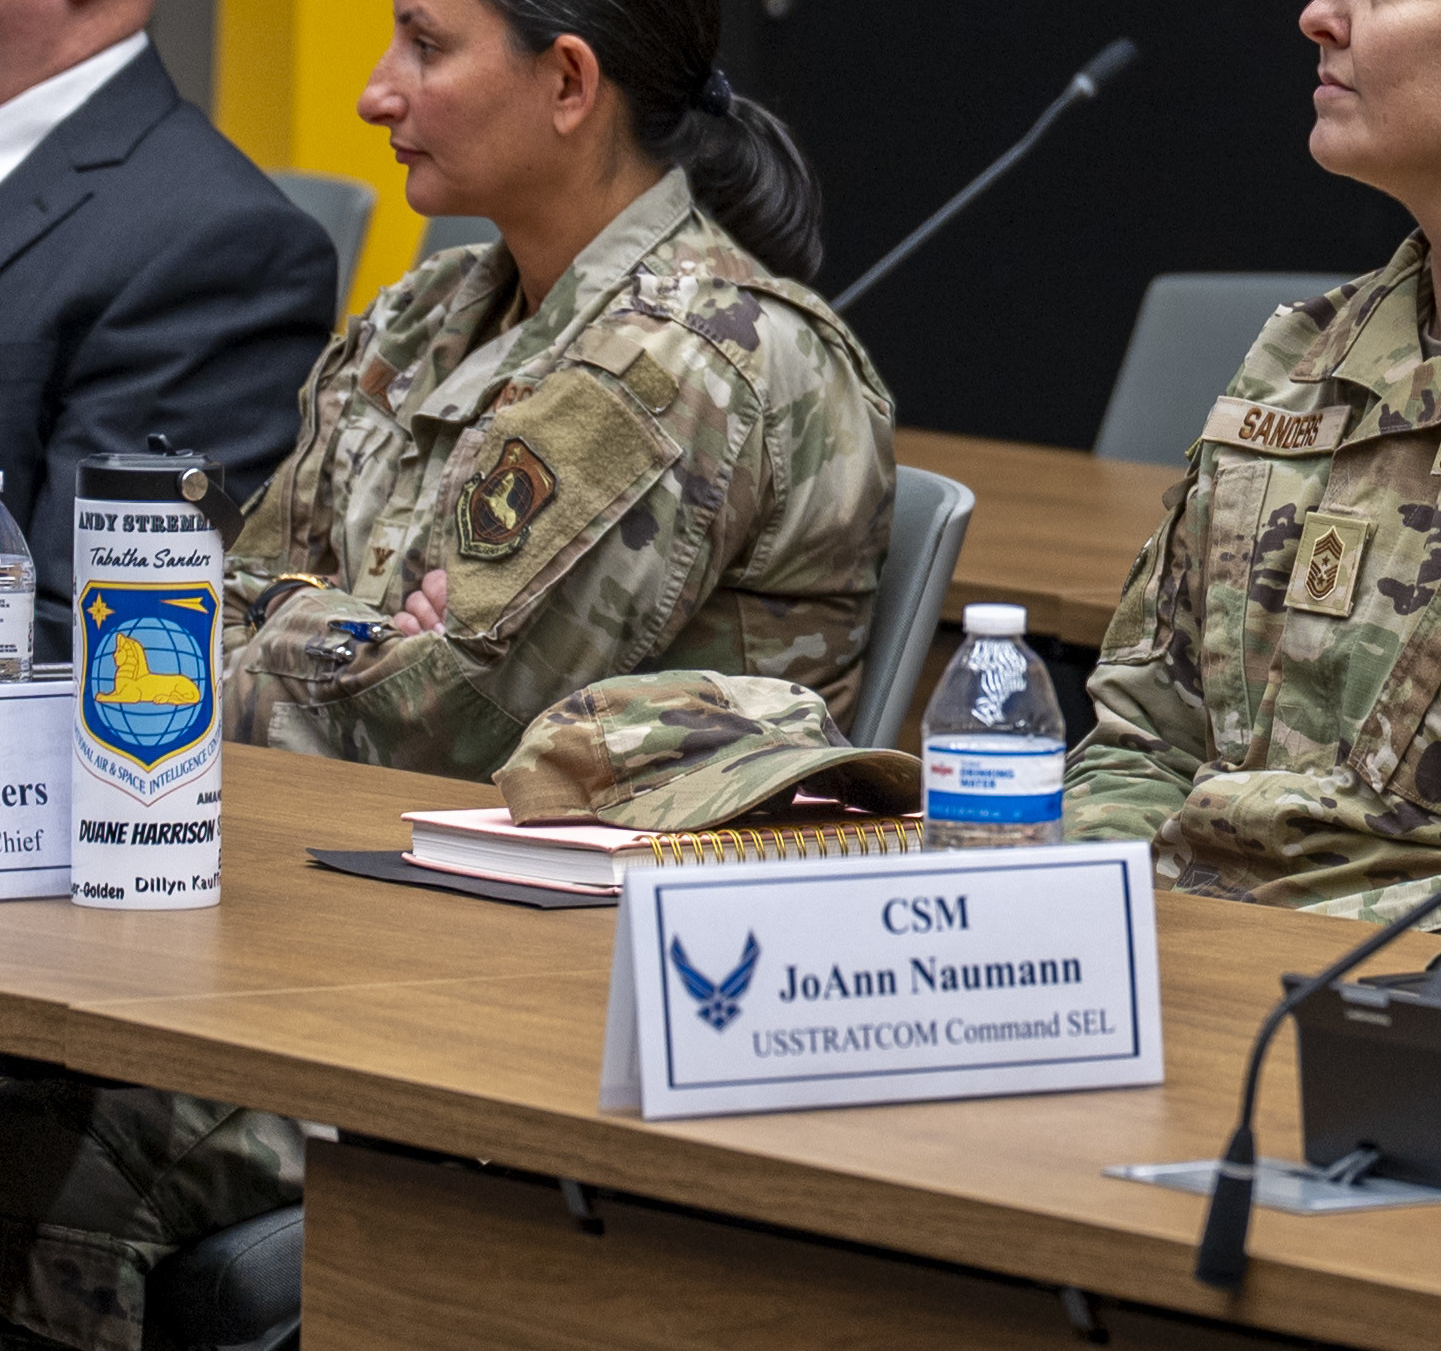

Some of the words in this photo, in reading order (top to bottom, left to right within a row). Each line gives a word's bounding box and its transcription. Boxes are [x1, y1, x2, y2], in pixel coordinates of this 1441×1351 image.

[1239, 407, 1323, 448] SANDERS
[78, 511, 118, 532] ANDY
[123, 512, 216, 534] STREMM
[90, 547, 149, 568] Tabatha
[153, 548, 211, 569] Sanders
[74, 718, 93, 763] TIONAL
[94, 752, 109, 771] AIR
[109, 762, 116, 775] &
[117, 765, 146, 795] SPACE
[149, 751, 207, 796] INTELLIGENCE
[79, 819, 129, 845] DUANE
[131, 818, 215, 845] HARRISON
[135, 876, 186, 896] Dillyn
[881, 895, 970, 936] CSM
[779, 964, 897, 1004] JoAnn
[910, 955, 1082, 997] Naumann
[752, 1019, 938, 1060] USSTRATCOM
[945, 1011, 1060, 1046] Command
[1067, 1008, 1116, 1038] SEL
